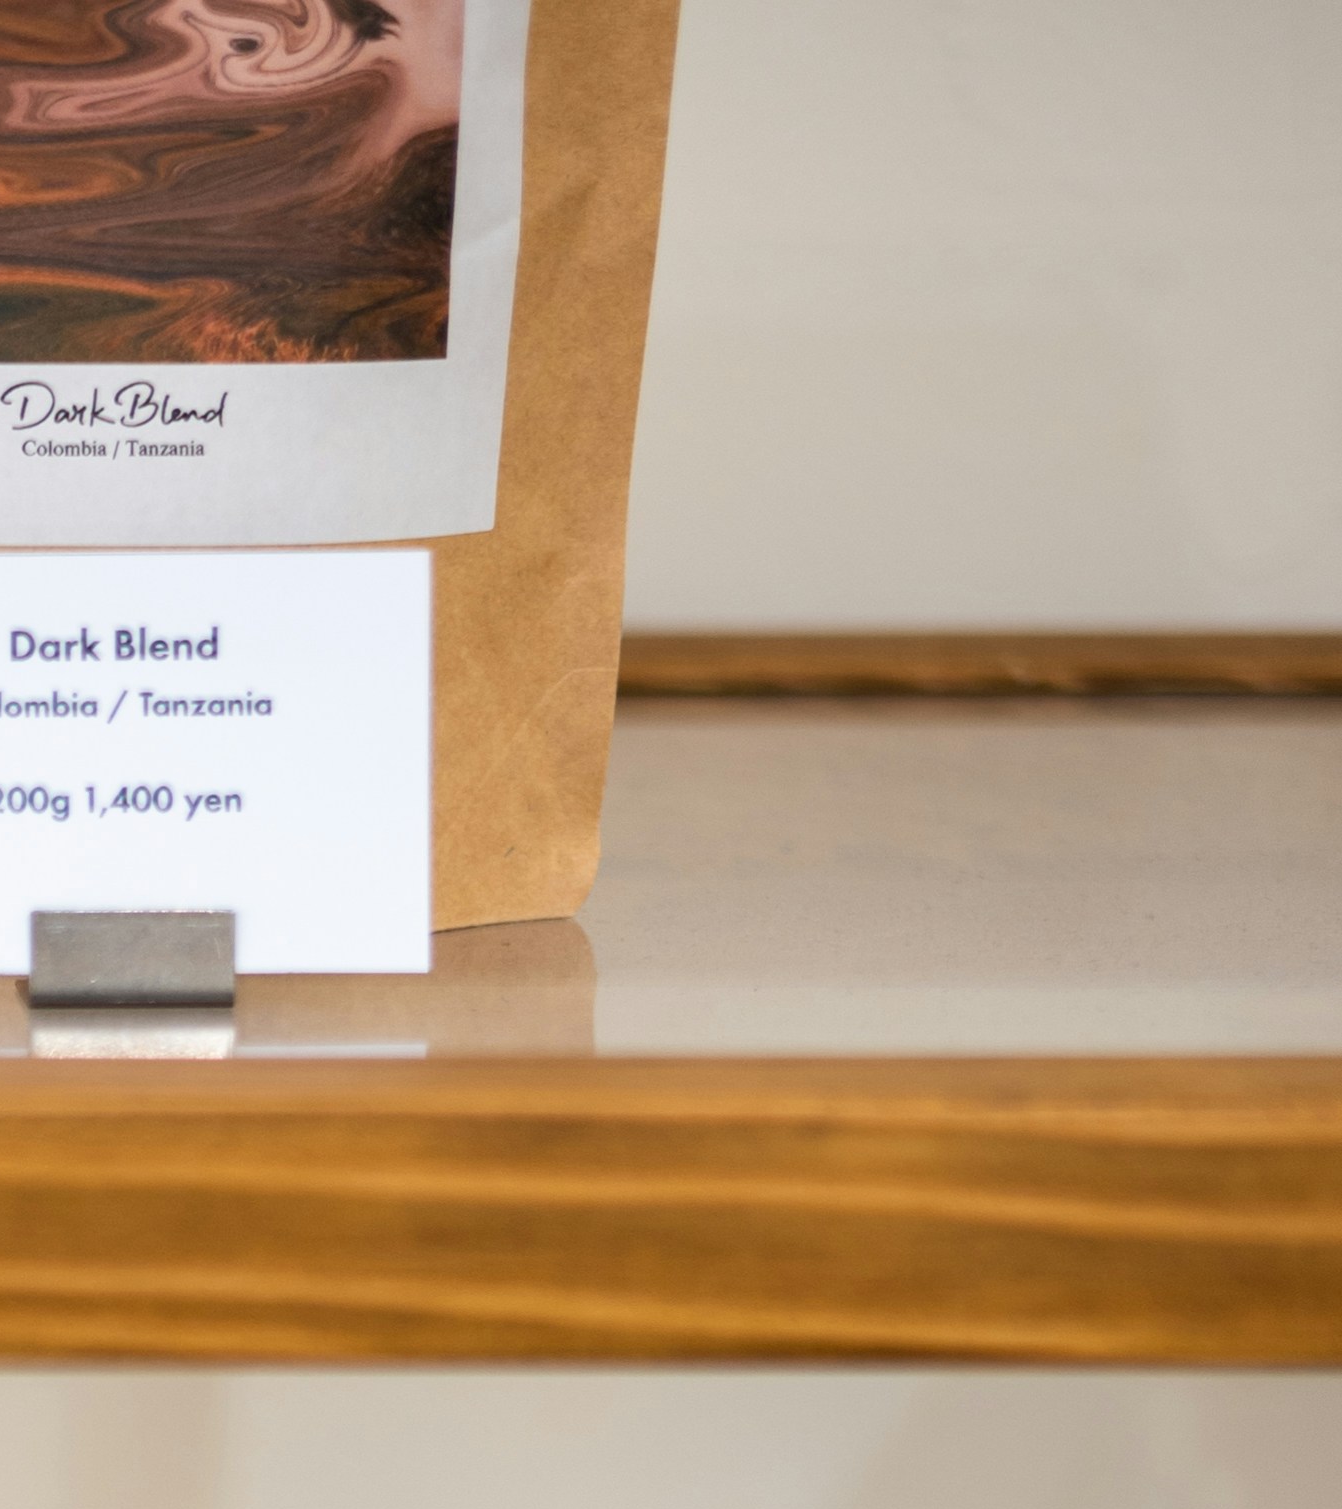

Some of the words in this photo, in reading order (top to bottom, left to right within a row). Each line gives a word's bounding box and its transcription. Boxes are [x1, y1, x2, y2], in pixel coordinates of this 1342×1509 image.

[0, 381, 116, 431] Dark
[114, 381, 228, 428] Blend
[21, 439, 107, 457] Colombia
[125, 439, 205, 457] Tanzania
[10, 627, 100, 661] Dark
[114, 626, 219, 660] Blend
[139, 691, 273, 716] Tanzania
[85, 785, 174, 819] 1,400
[184, 793, 242, 820] yen
